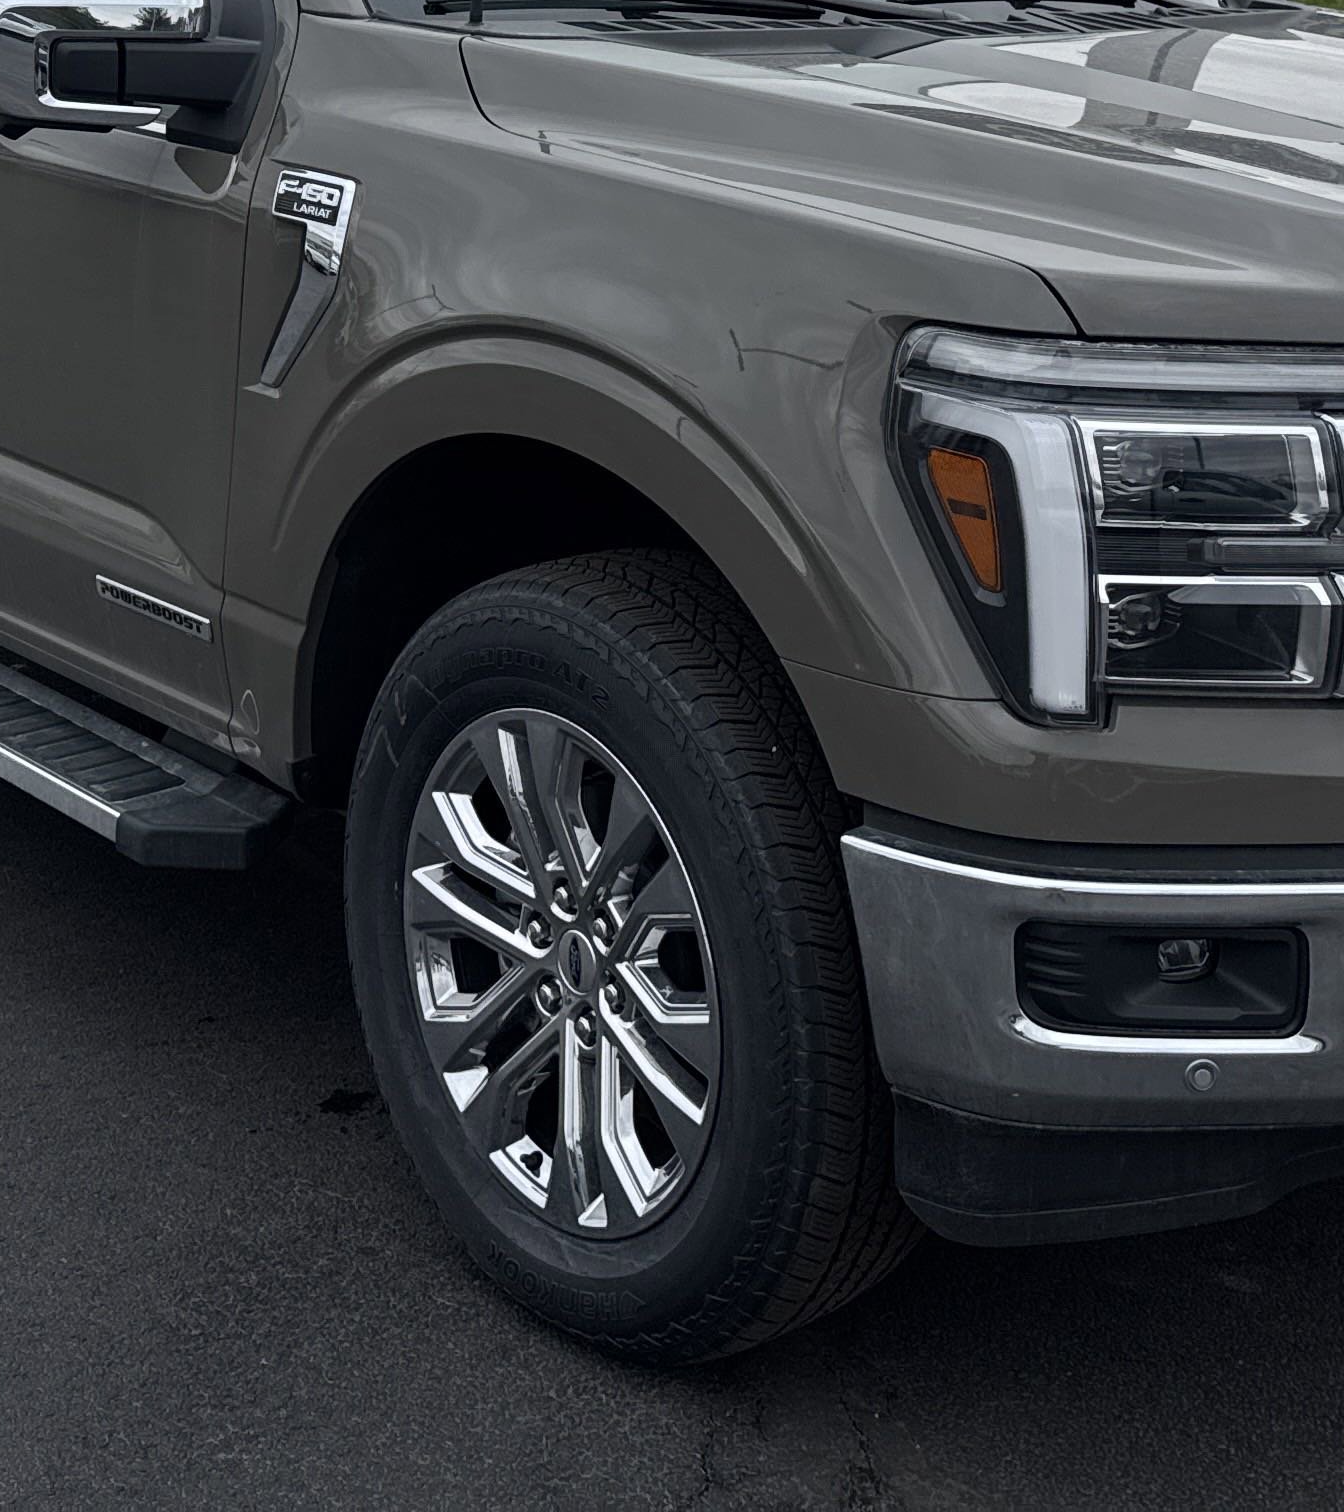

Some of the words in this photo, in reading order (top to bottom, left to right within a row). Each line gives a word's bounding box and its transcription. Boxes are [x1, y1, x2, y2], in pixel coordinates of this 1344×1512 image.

[277, 179, 341, 207] F-150
[293, 202, 333, 219] LARIAT
[100, 581, 204, 634] POWERBOOST
